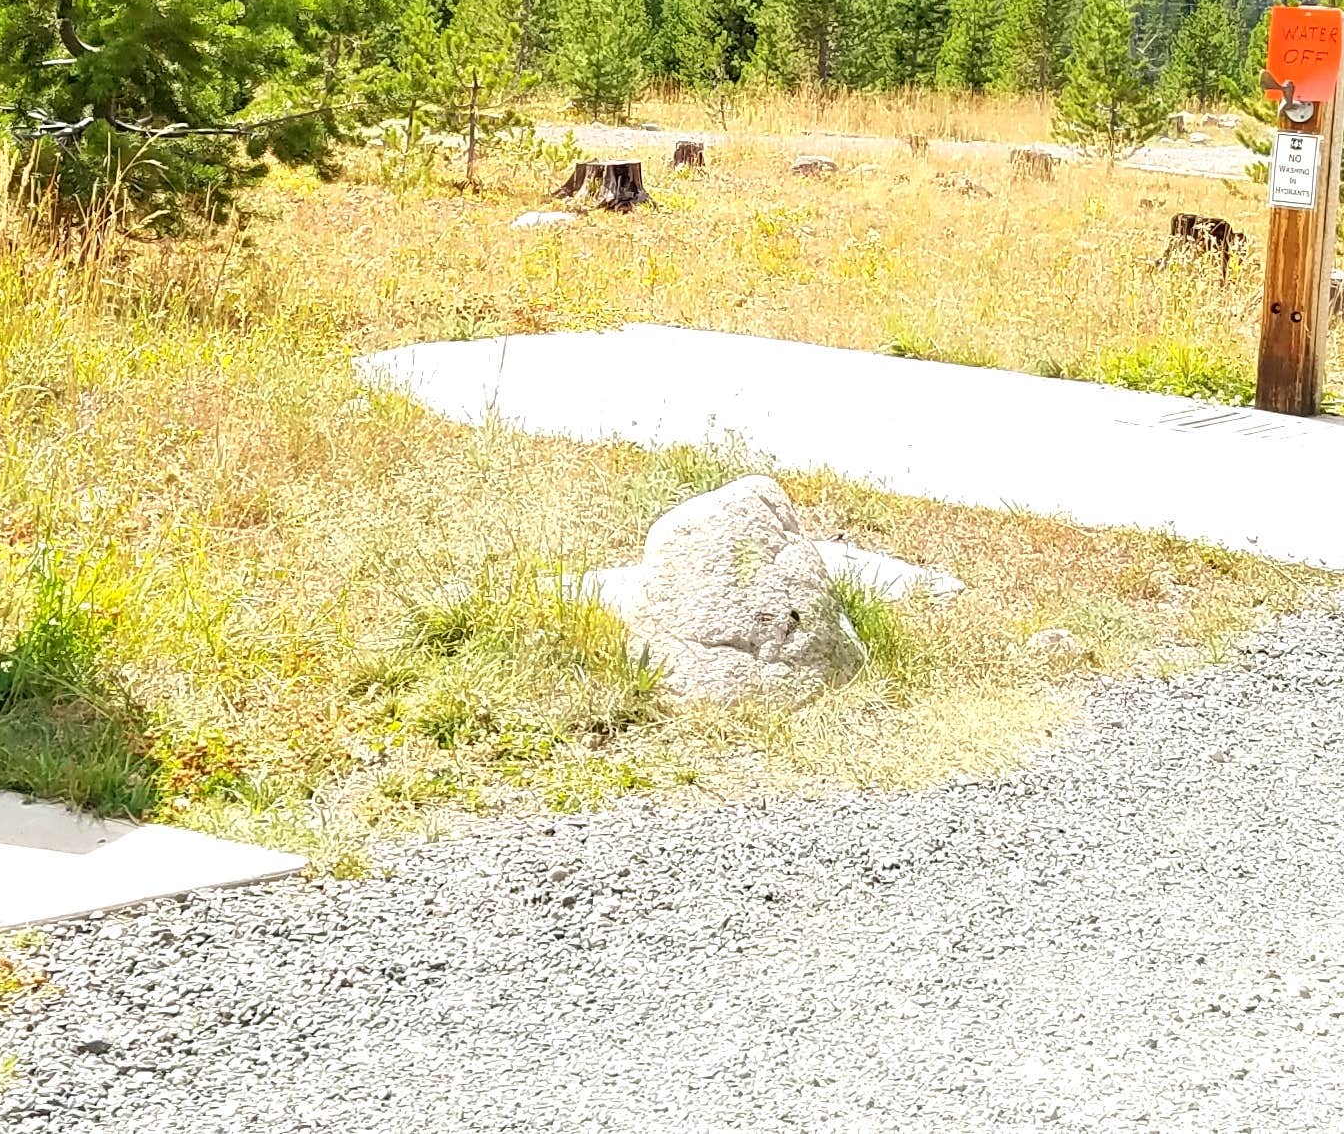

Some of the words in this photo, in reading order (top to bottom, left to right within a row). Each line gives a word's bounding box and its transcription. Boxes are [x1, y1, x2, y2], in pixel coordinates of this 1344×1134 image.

[1282, 25, 1339, 43] WATER
[1283, 49, 1329, 65] OFF
[1288, 153, 1302, 163] NO
